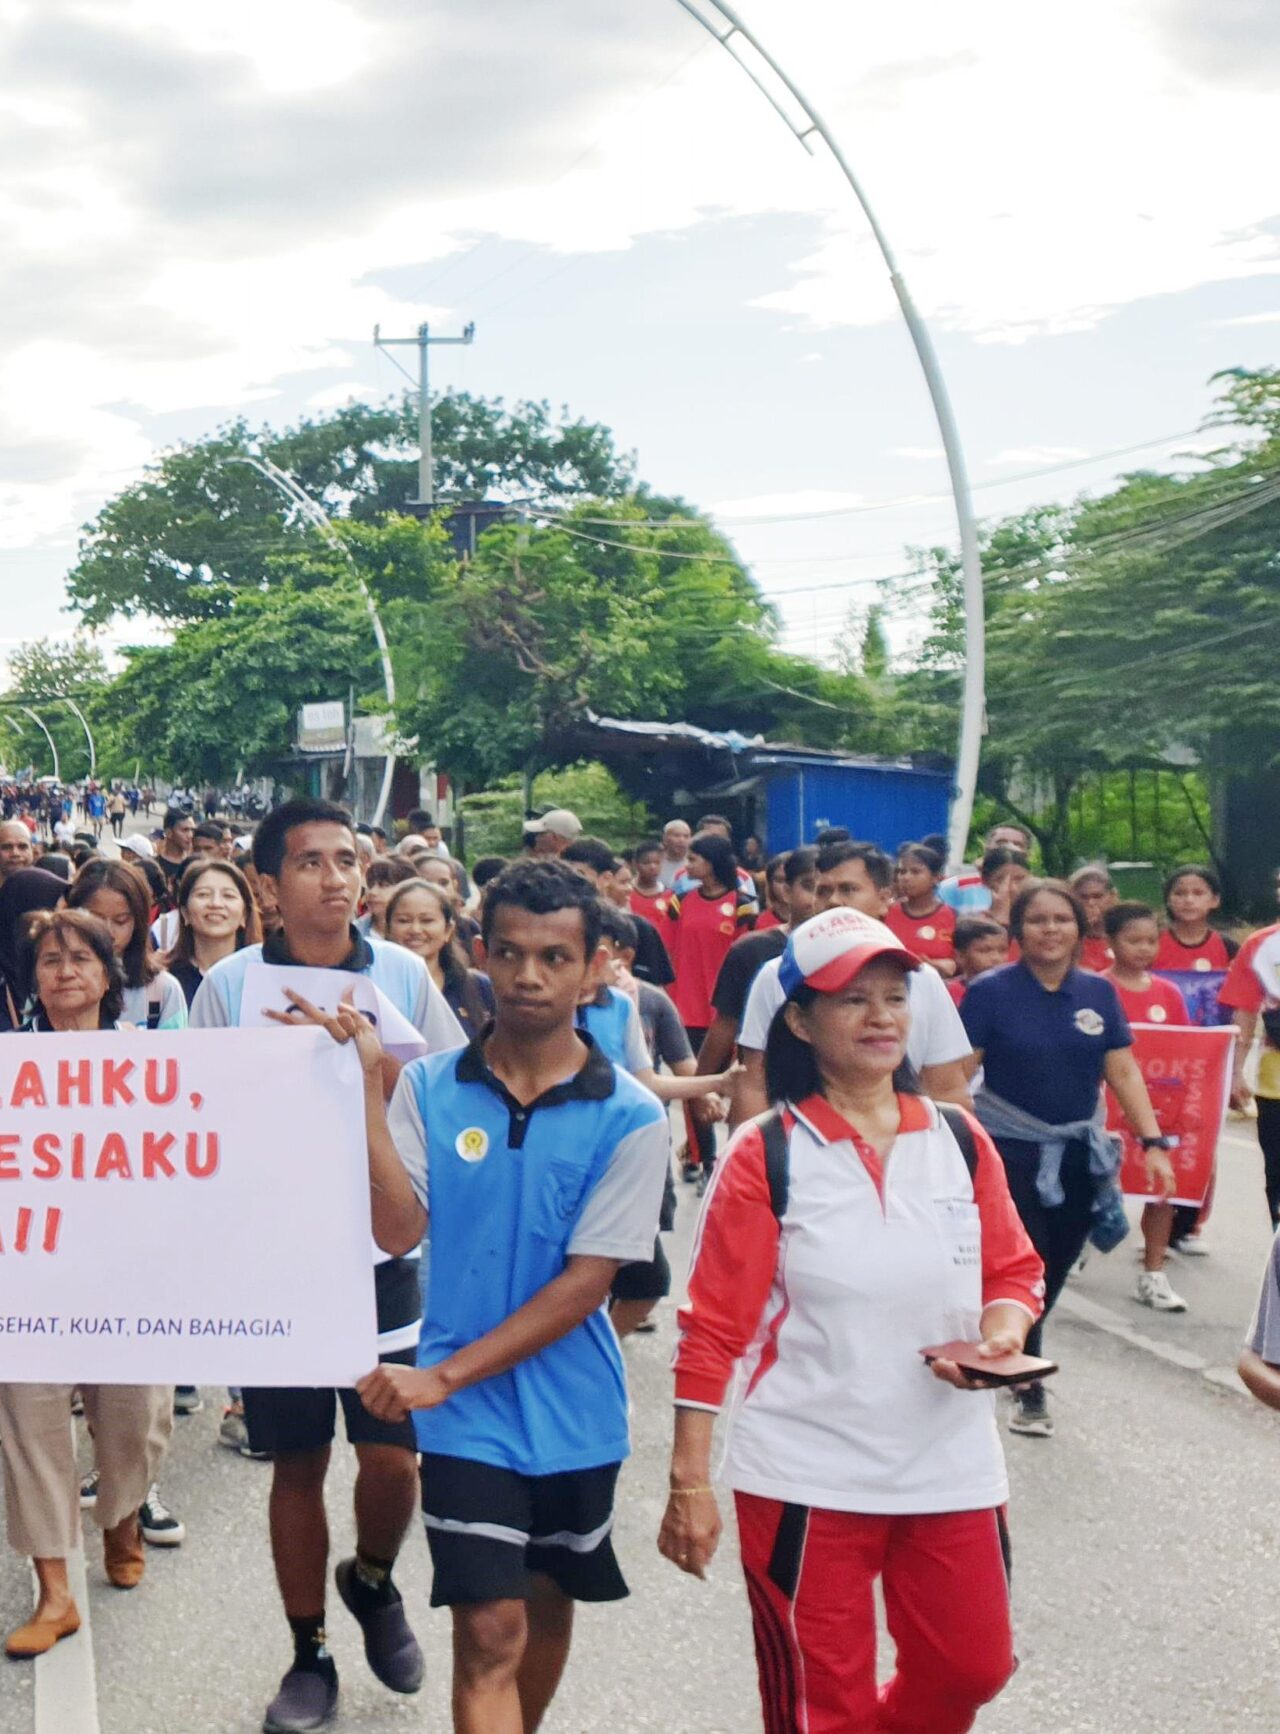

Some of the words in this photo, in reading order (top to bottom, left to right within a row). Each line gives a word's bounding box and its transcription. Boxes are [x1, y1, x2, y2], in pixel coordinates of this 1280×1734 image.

[69, 1317, 131, 1338] KUAT,
[136, 1317, 184, 1336] DAN
[188, 1318, 293, 1338] BAHAGIA!
